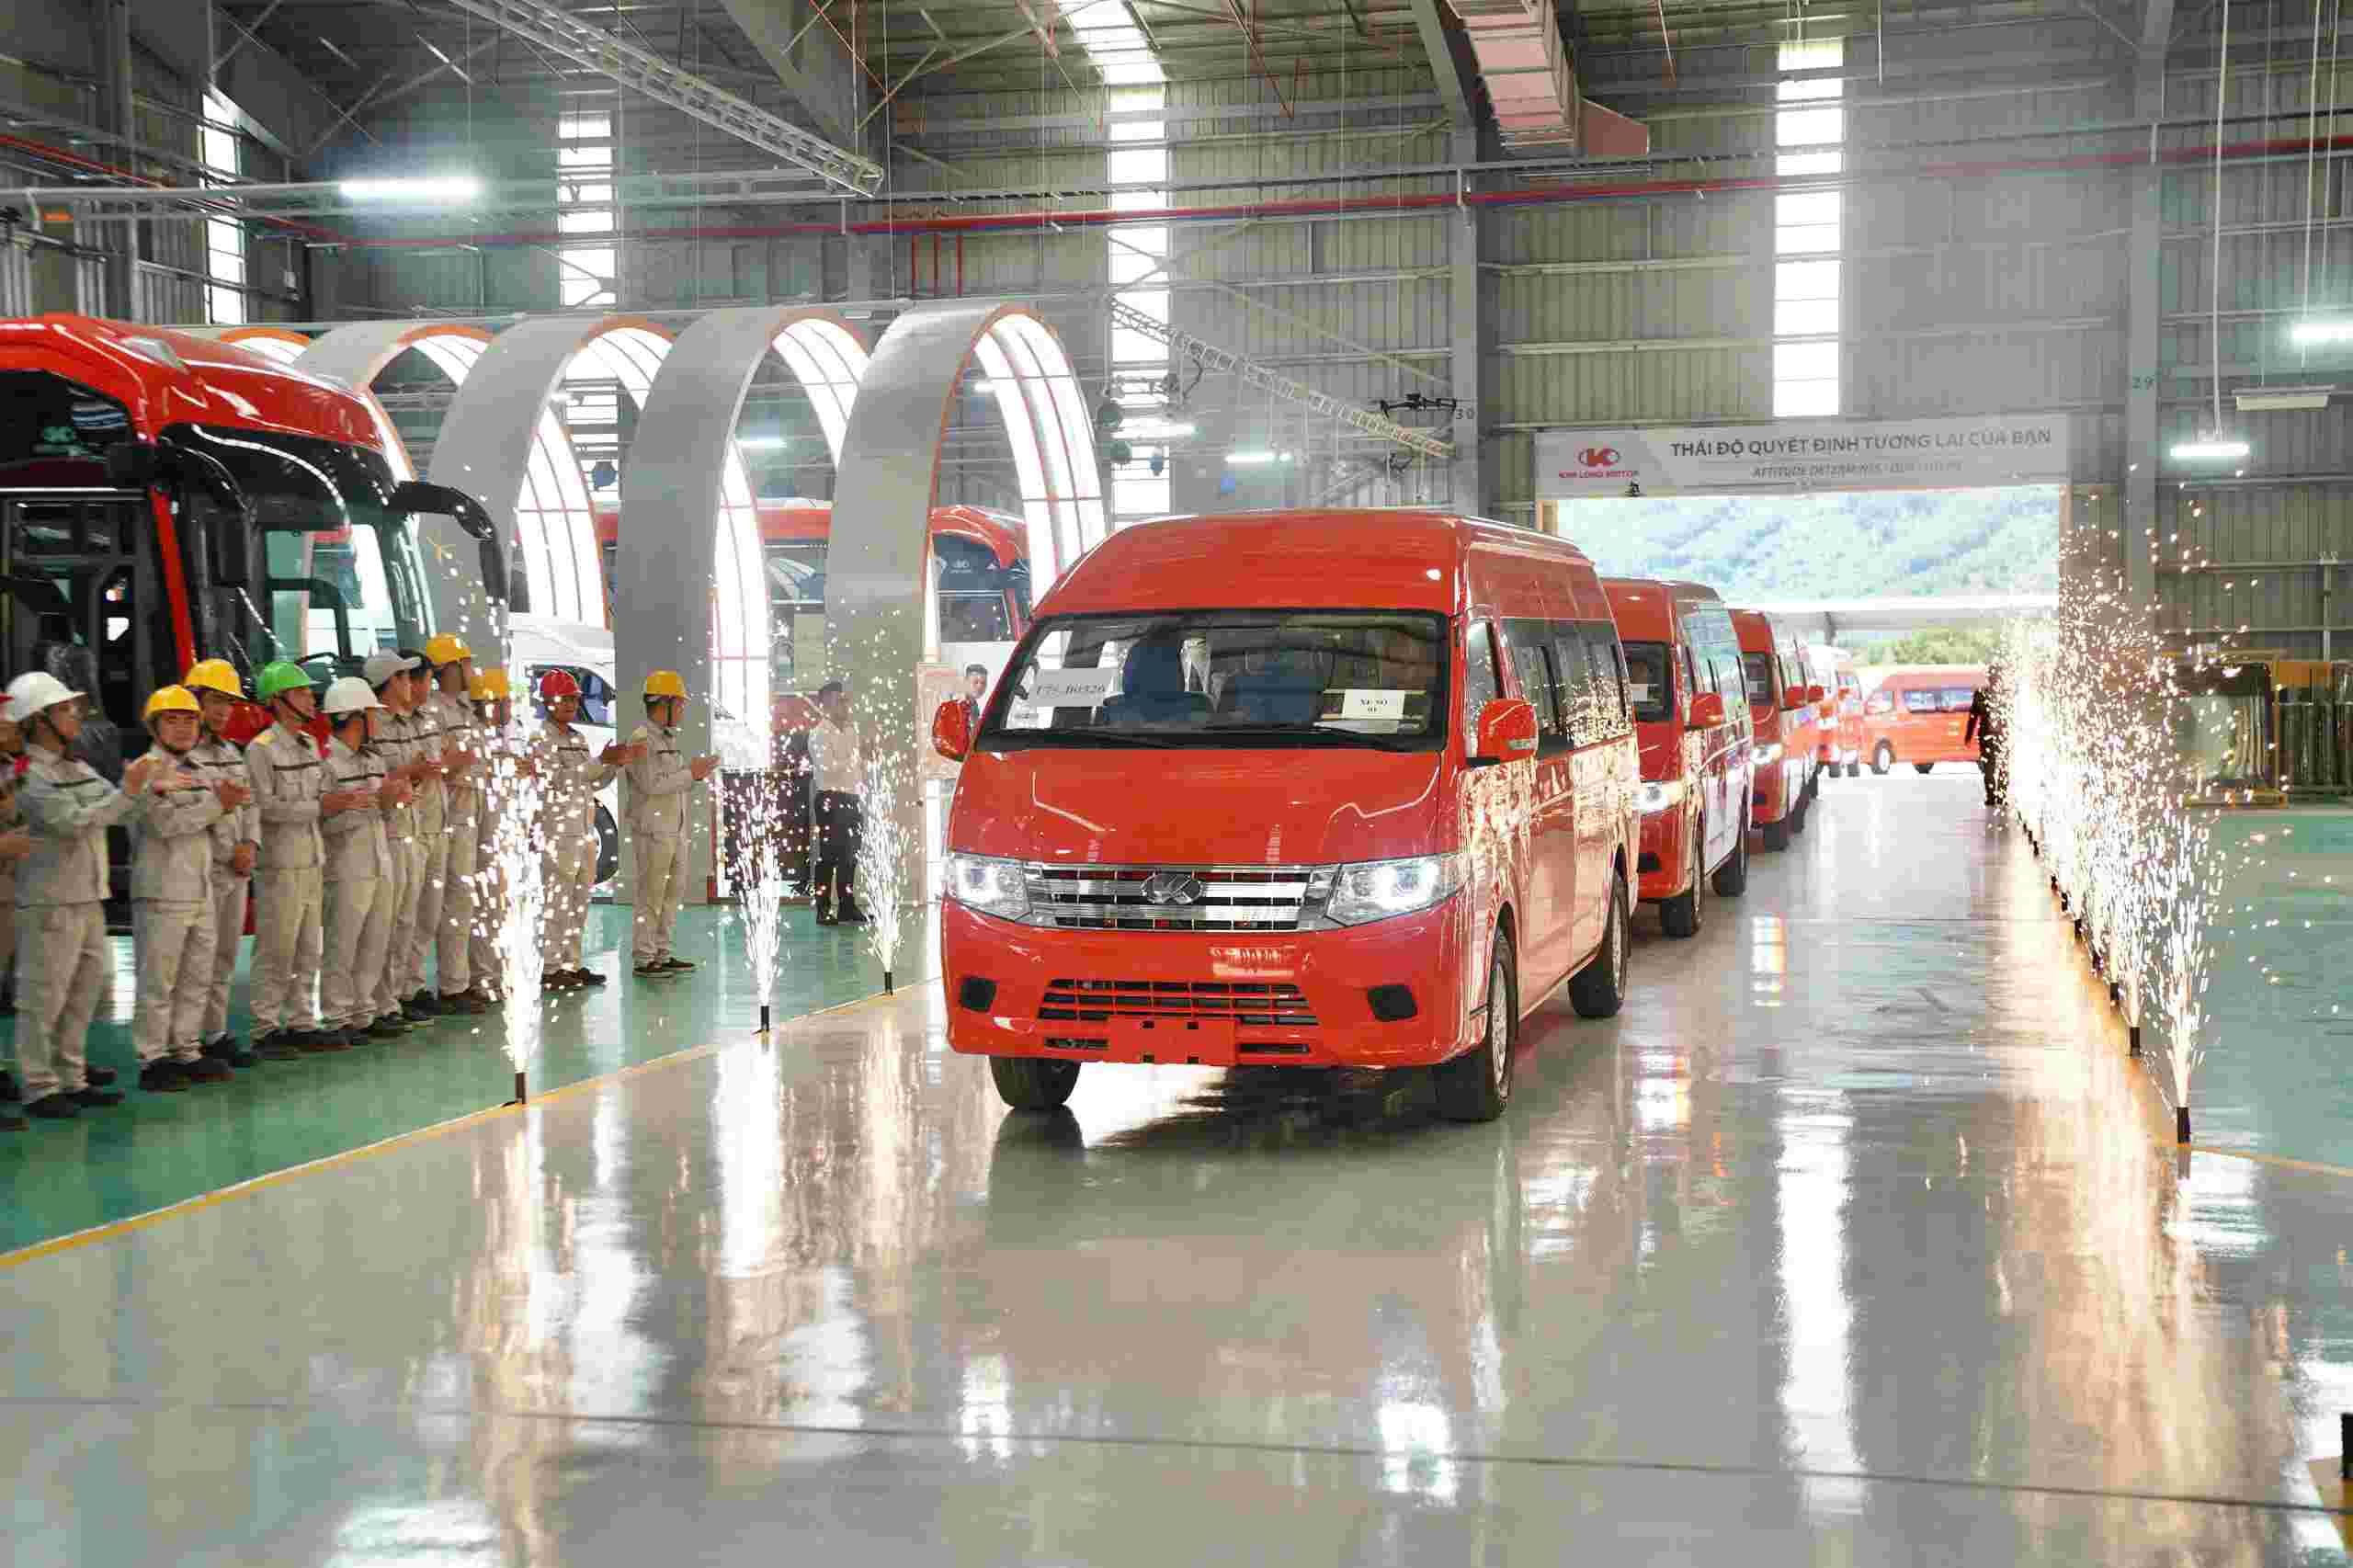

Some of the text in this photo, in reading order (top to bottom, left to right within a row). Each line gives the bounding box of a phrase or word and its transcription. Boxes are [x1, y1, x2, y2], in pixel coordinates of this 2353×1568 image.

[1669, 435, 1711, 456] THÁI
[1716, 437, 1744, 459] ĐỘ
[1748, 434, 1808, 454] QUYẾT
[1812, 436, 1859, 456] ĐỊNH
[1935, 432, 1964, 449] LAI
